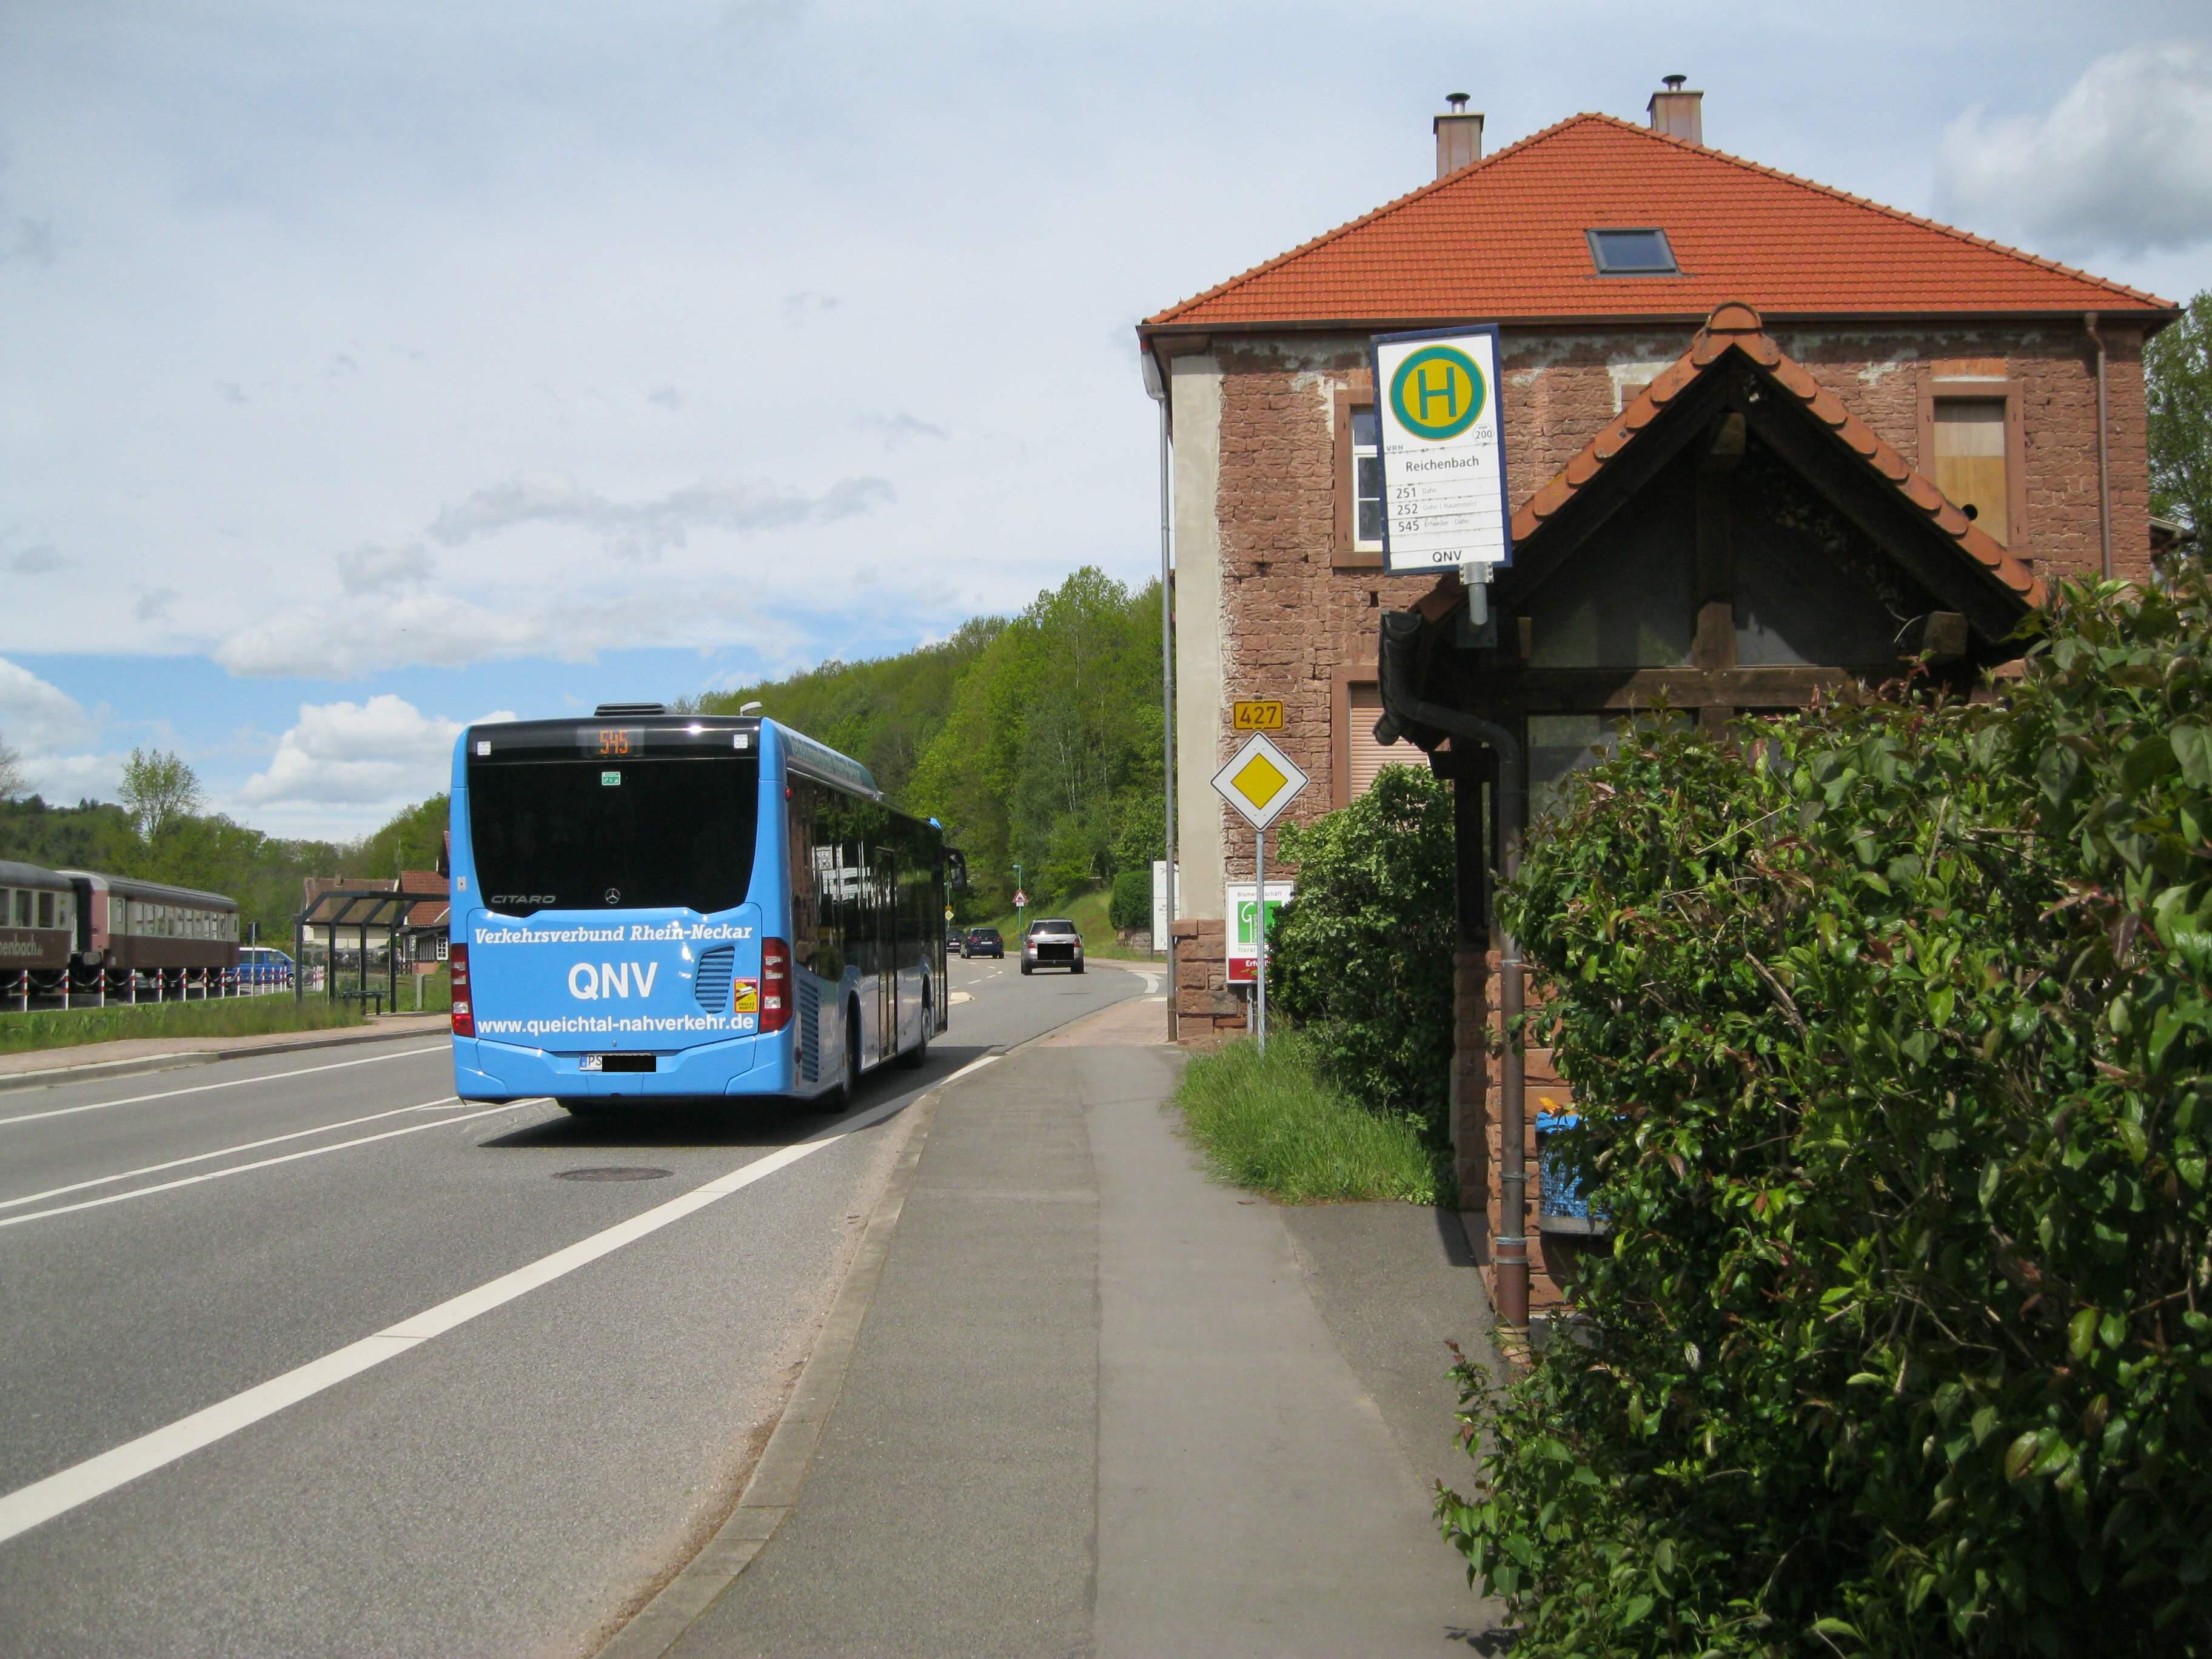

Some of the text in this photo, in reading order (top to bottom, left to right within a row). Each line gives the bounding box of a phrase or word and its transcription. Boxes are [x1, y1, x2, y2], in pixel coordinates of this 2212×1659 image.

[1418, 366, 1457, 420] H
[1475, 429, 1492, 439] 200
[1405, 455, 1480, 472] Reichenbach
[1396, 487, 1416, 499] 251
[1397, 503, 1418, 515] 252
[1398, 520, 1419, 532] 545
[1432, 550, 1462, 563] QNV
[1239, 706, 1278, 724] 427
[599, 729, 629, 754] 545
[491, 894, 556, 904] CITARO
[475, 924, 752, 943] Verkehrsverbund Rhein-Neckar
[568, 962, 659, 1000] QNV
[477, 1014, 754, 1034] www.queichtal-nahverkehr.de
